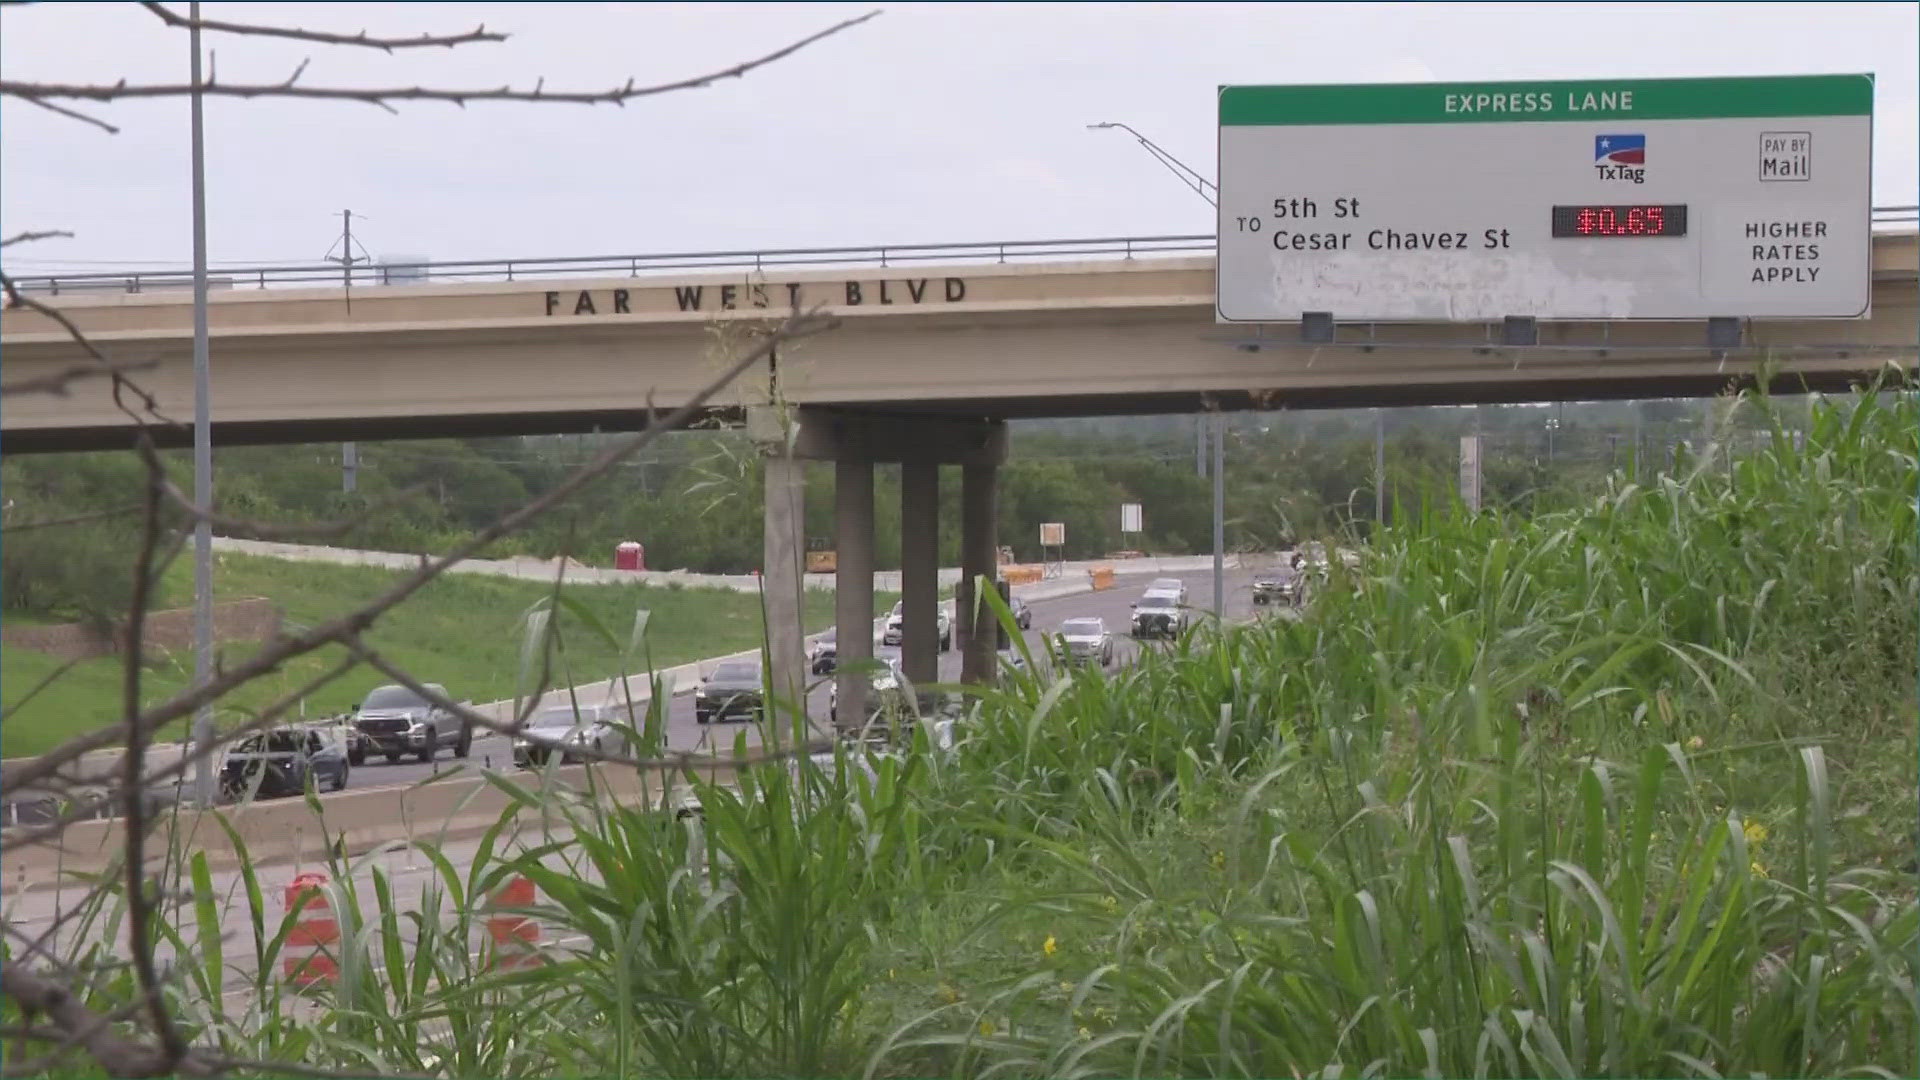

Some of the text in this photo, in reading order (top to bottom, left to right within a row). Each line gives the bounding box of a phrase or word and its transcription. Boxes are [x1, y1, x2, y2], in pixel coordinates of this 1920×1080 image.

[1444, 91, 1633, 113] EXPRESS LANE
[1765, 139, 1806, 152] PAY BY
[1594, 165, 1645, 184] TxTag
[1763, 155, 1806, 176] Mail
[1274, 197, 1360, 218] 5th St
[1237, 216, 1261, 232] TO
[1577, 206, 1664, 236] $0.65
[1745, 221, 1827, 238] HIGHER
[1273, 228, 1510, 250] Cesar Chavez St
[1752, 244, 1819, 260] RATES
[1751, 267, 1820, 283] APPLY
[544, 289, 631, 316] FAR
[845, 277, 966, 306] BLVD
